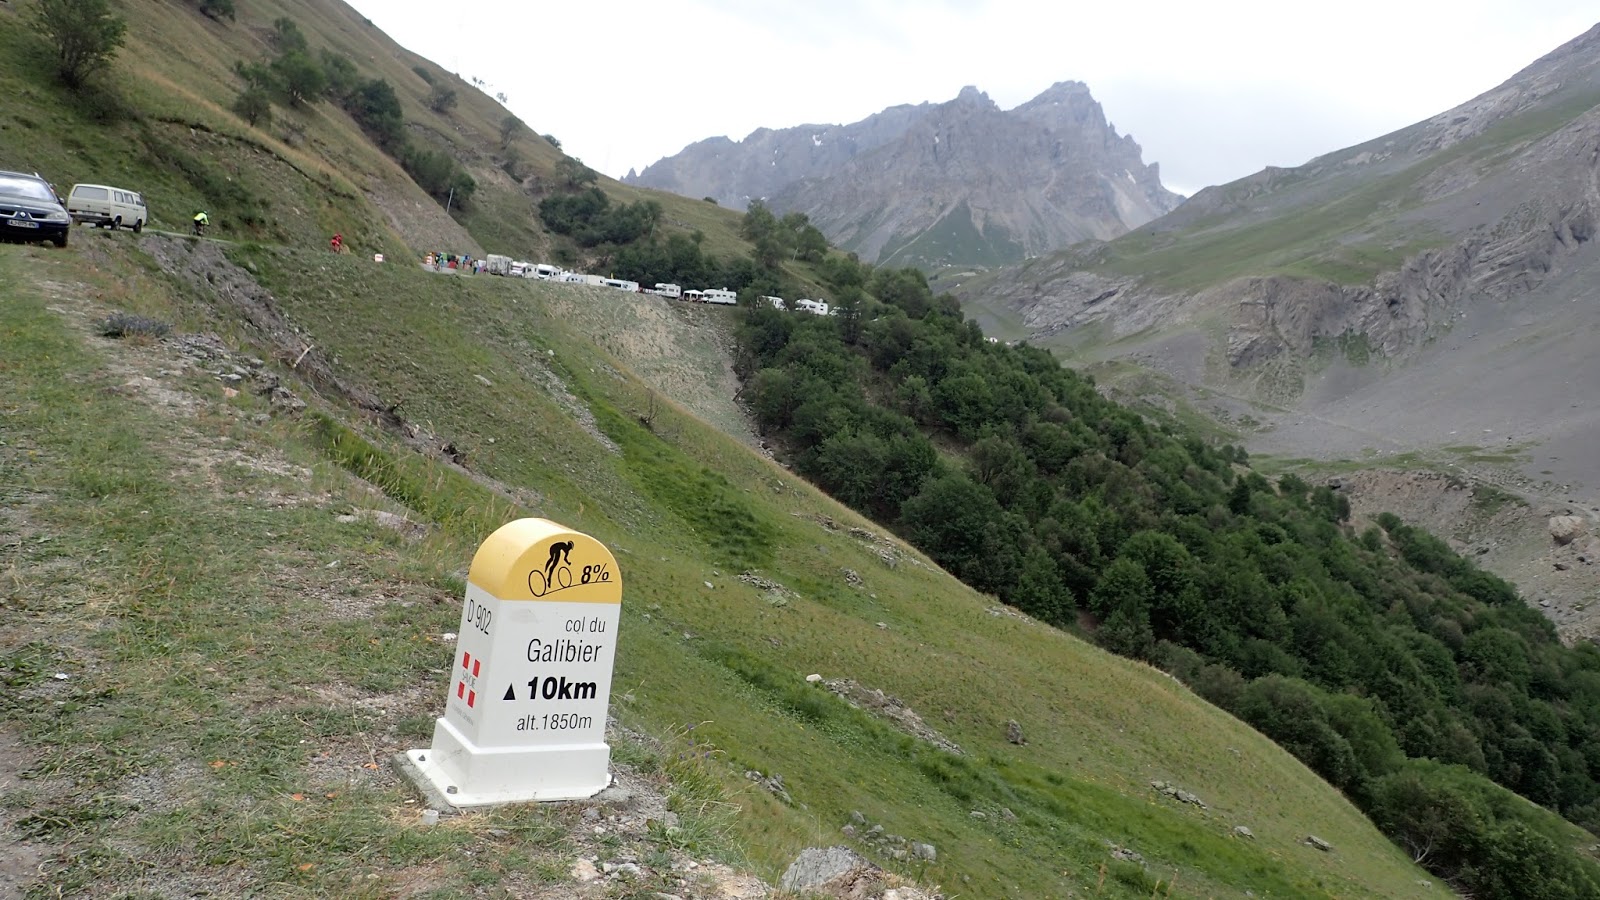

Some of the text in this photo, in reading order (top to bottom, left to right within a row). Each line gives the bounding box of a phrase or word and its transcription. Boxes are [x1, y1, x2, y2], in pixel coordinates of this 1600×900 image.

[581, 563, 610, 585] 8%
[467, 598, 492, 635] D 902
[565, 616, 606, 633] col du
[527, 638, 602, 663] Galibier
[527, 676, 597, 700] 10km
